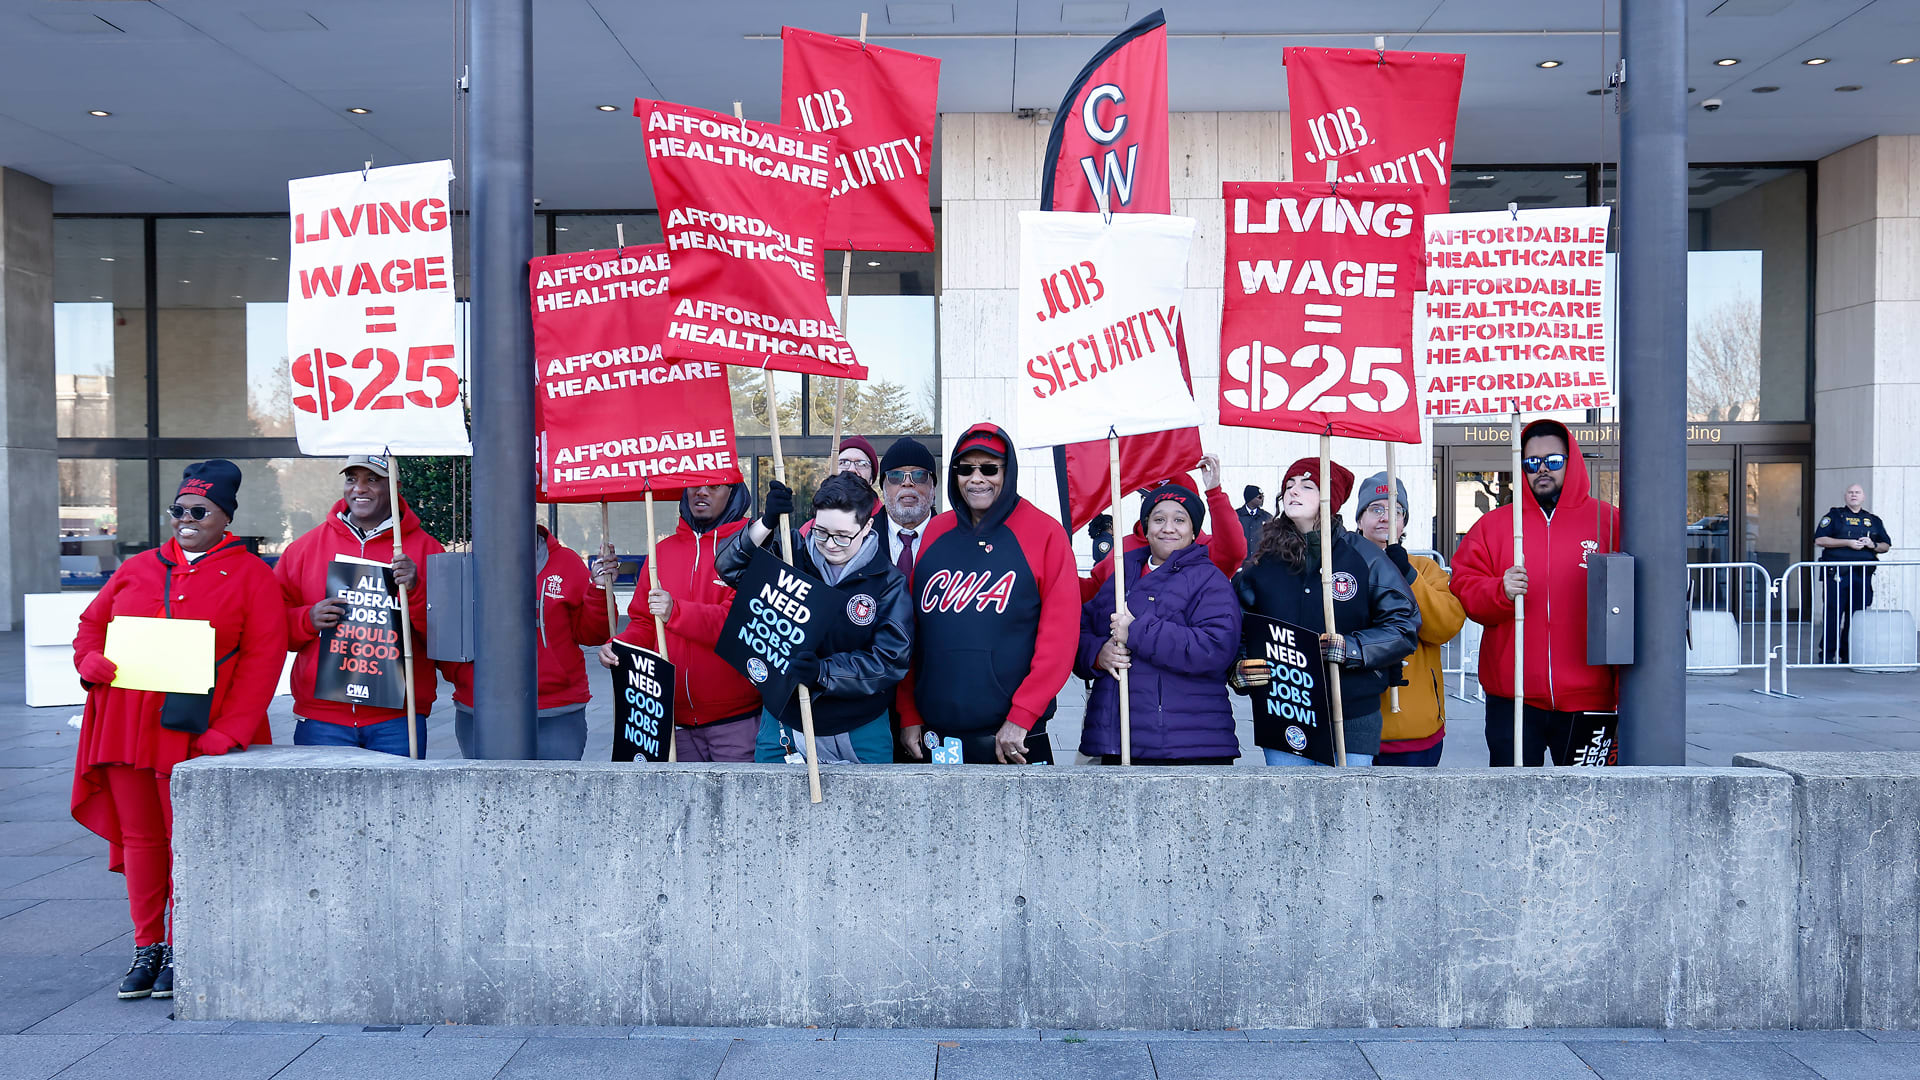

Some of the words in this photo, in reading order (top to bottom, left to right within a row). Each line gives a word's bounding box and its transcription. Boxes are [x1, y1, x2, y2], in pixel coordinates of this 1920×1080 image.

[795, 88, 853, 133] JOB
[648, 111, 829, 164] AFFORDABLE
[1304, 106, 1368, 164] JOB
[649, 137, 829, 189] HEALTHCARE
[295, 198, 448, 243] LIVING
[1234, 197, 1414, 238] LIVING
[1428, 227, 1605, 246] AFFORDABLE
[536, 253, 671, 290] AFFORDAB
[1426, 249, 1605, 269] HEALTHCARE
[299, 256, 447, 299] WAGE
[1036, 260, 1104, 322] JOB
[1237, 260, 1398, 298] WAGE
[1428, 277, 1602, 297] AFFORDABLE
[537, 276, 669, 313] HEALTHCA
[1426, 300, 1602, 319] HEALTHCARE
[365, 306, 397, 333] =
[674, 298, 846, 343] AFFORDABLE
[1304, 303, 1342, 334] =
[1428, 322, 1604, 342] AFFORDABLE
[668, 321, 855, 365] HEALTHCARE
[1027, 305, 1176, 398] SECURITY
[1426, 344, 1606, 365] HEALTHCARE
[546, 344, 664, 377] AFFORDA
[1223, 340, 1410, 413] $25
[292, 344, 460, 421] $25
[546, 361, 722, 399] HEALTHCARE
[1427, 371, 1607, 393] AFFORDABLE
[1425, 391, 1611, 416] HEALTHCARE
[554, 429, 727, 465] AFFORDABLE
[1687, 425, 1721, 442] ding
[553, 451, 733, 483] HEALTHCARE
[337, 589, 402, 610] FEDERAL
[357, 575, 385, 592] ALL
[777, 568, 812, 601] WE
[921, 569, 1016, 614] CWA
[348, 607, 388, 625] JOBS
[759, 582, 811, 624] NEED
[335, 623, 398, 644] SHOULD
[746, 617, 793, 657] JOBS
[749, 598, 806, 645] GOOD
[1268, 623, 1296, 647] WE
[329, 639, 349, 655] BE
[350, 643, 400, 660] GOOD
[631, 653, 656, 677] WE
[738, 626, 790, 675] NOW!
[1265, 641, 1308, 669] NEED
[339, 657, 383, 676] JOBS.
[346, 683, 369, 698] CWA
[628, 669, 662, 698] NEED
[1269, 681, 1312, 707] JOBS
[625, 687, 664, 719] GOOD
[1266, 698, 1317, 728] NOW!
[628, 707, 659, 737] JOBS
[624, 723, 660, 758] NOW!
[1585, 726, 1606, 766] ERAL
[1596, 738, 1612, 767] OBS
